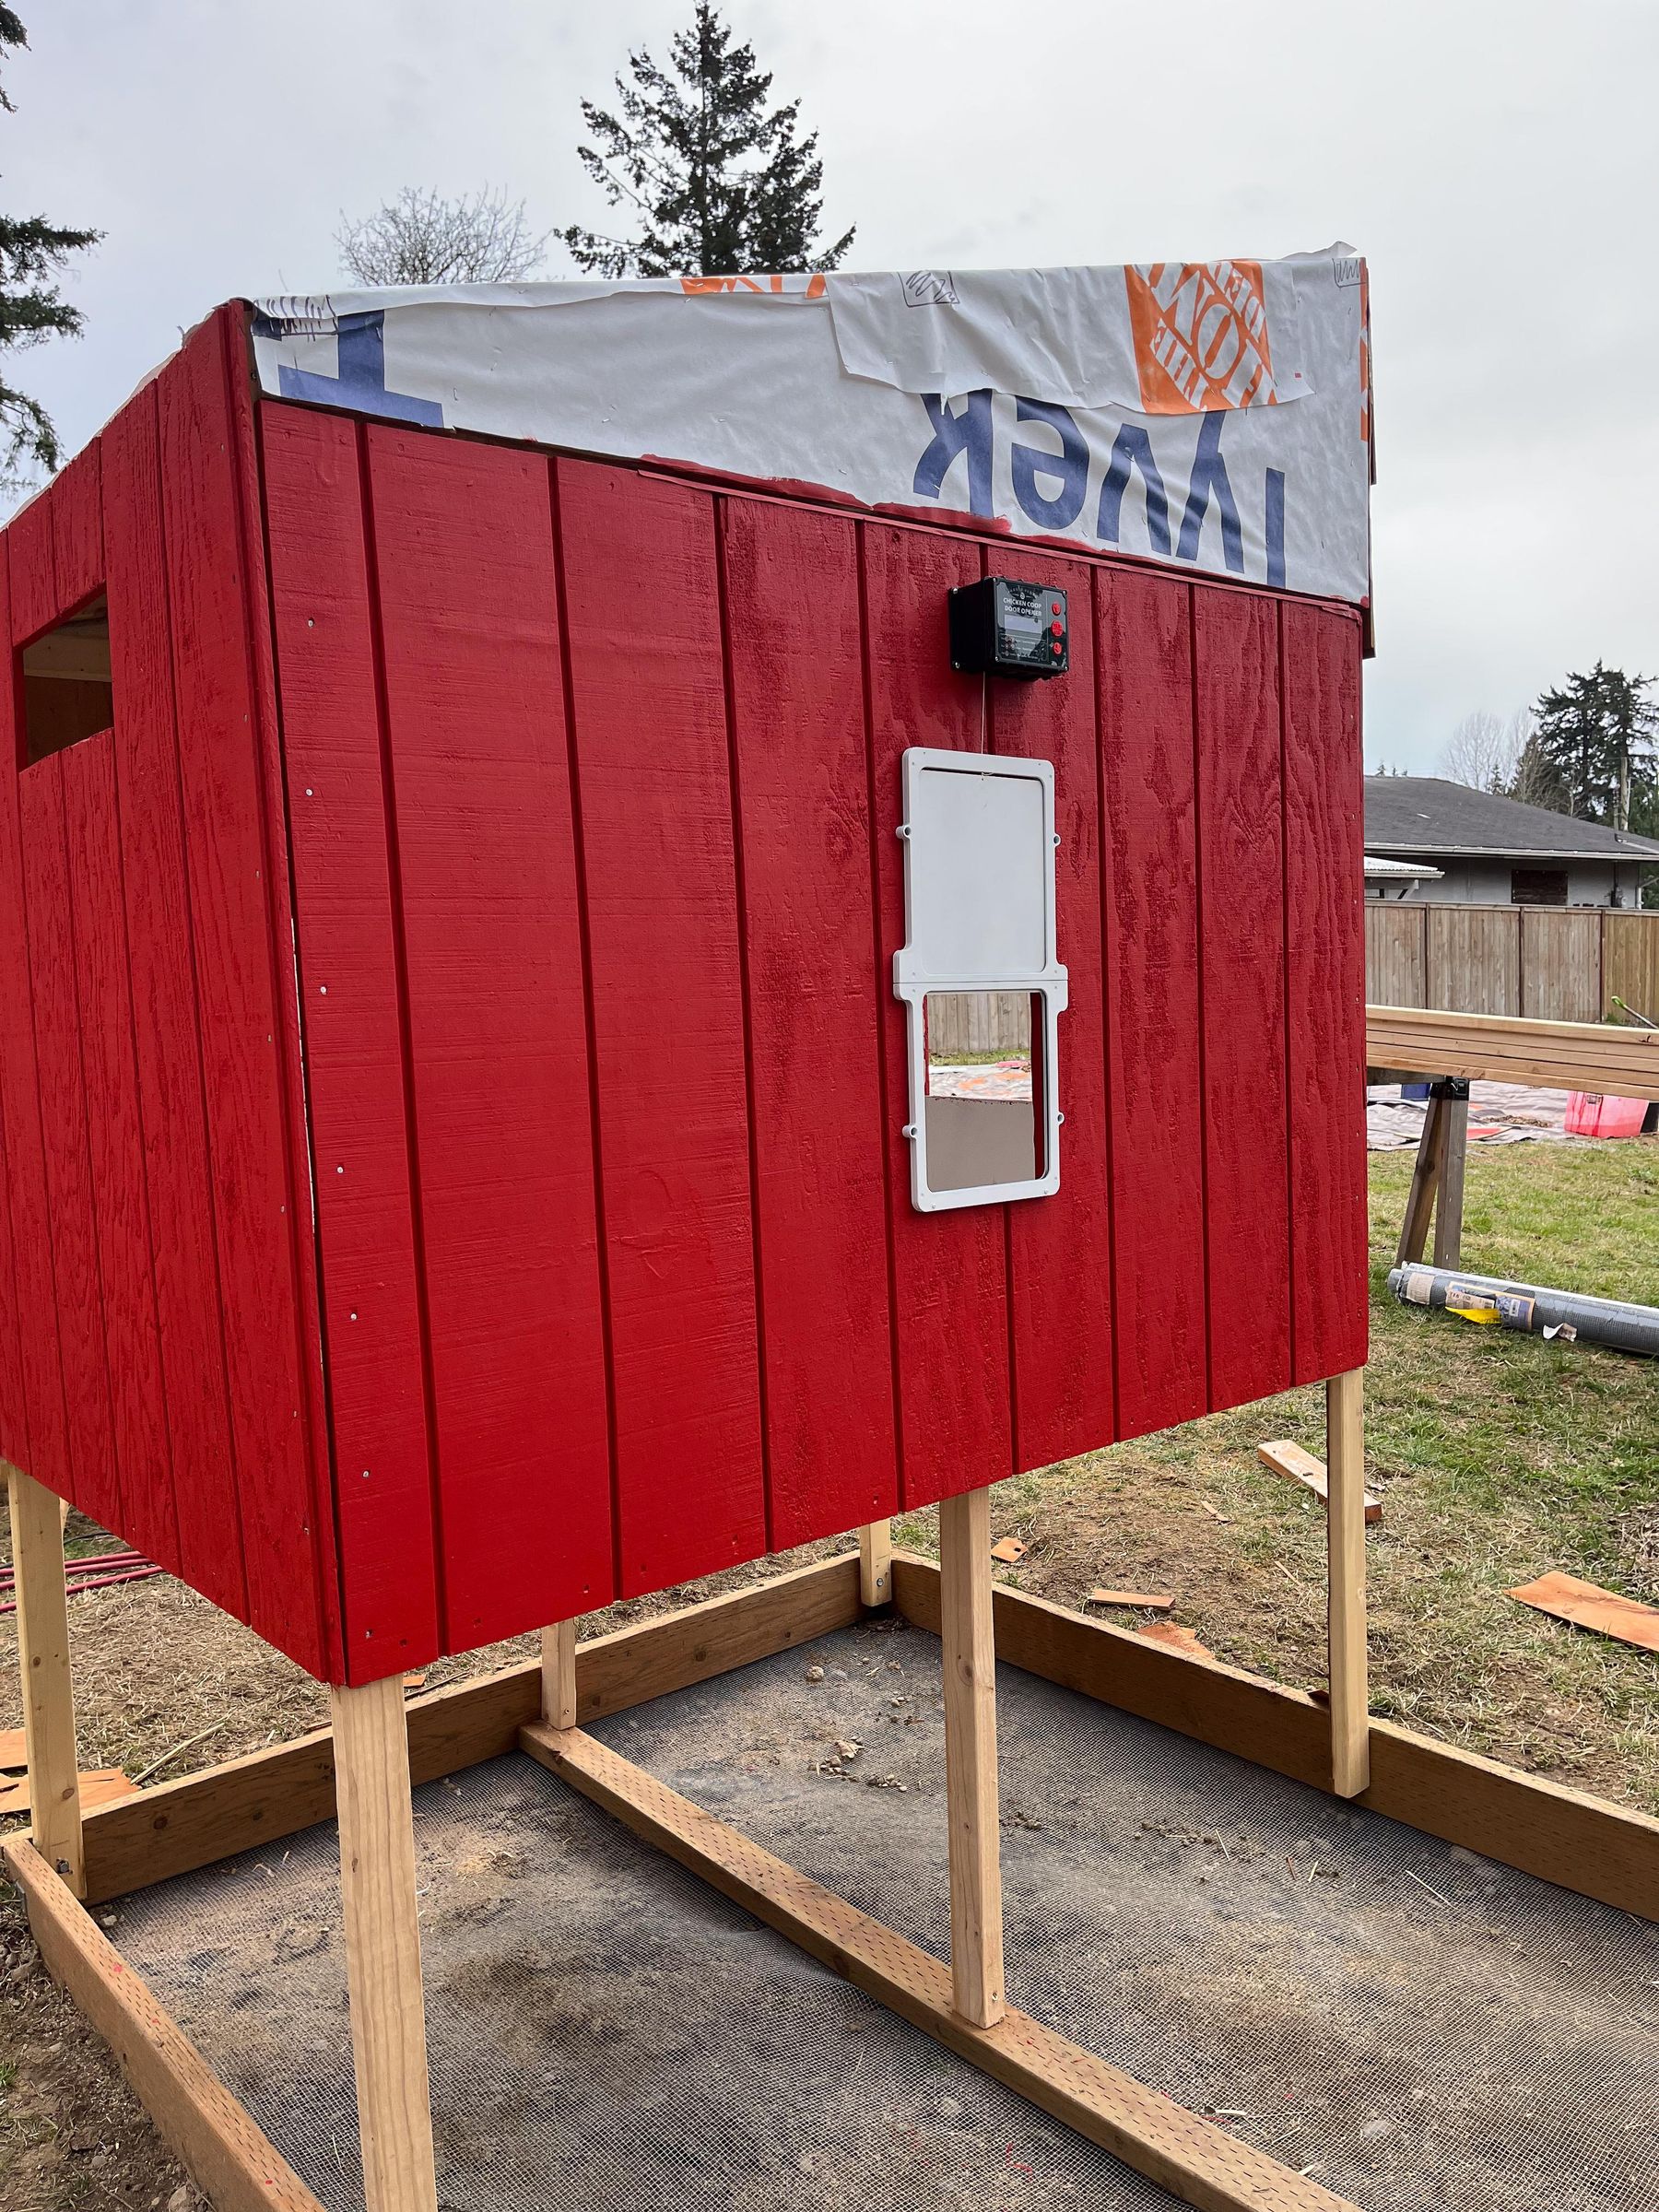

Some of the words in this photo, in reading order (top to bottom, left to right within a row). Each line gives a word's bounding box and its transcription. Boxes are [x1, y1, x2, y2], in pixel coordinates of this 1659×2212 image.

[1149, 317, 1209, 412] THE
[1003, 597, 1027, 606] CHICKEN
[1027, 601, 1042, 609] COOP
[1004, 605, 1020, 613] DOOR
[1020, 607, 1042, 617] OPENER
